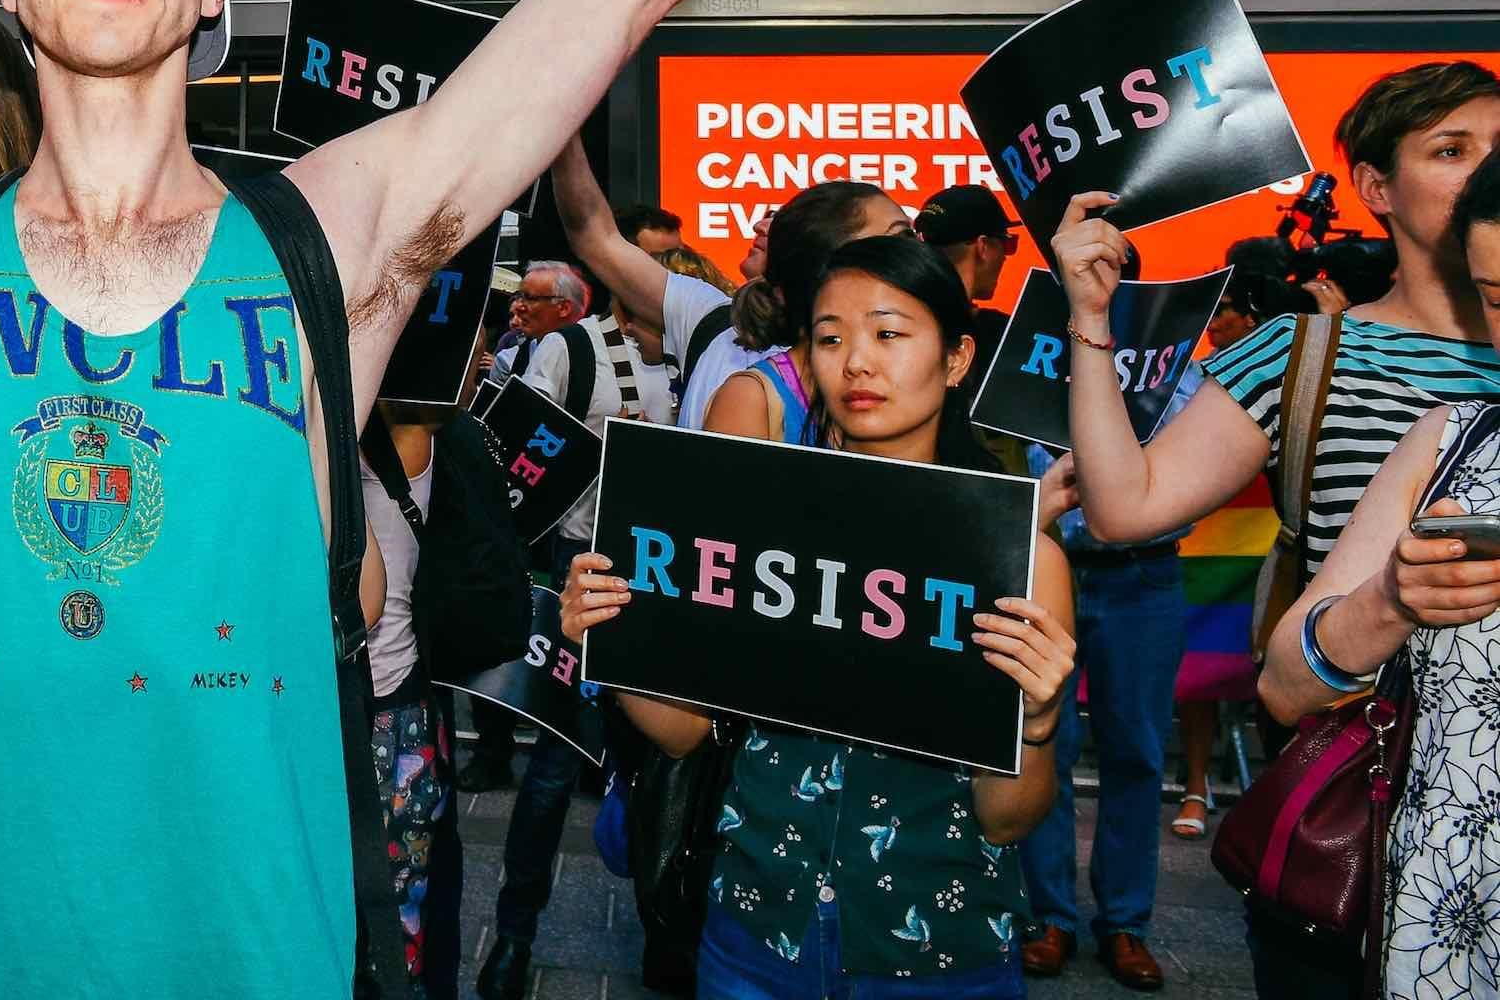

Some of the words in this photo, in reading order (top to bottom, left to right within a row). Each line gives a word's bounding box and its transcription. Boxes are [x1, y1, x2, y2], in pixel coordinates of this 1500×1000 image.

[302, 36, 437, 110] RESI
[697, 103, 981, 140] PIONEERIN
[1000, 47, 1222, 200] RESIST
[697, 152, 919, 191] CANCER
[932, 154, 1005, 191] TR
[1020, 333, 1192, 392] RSIST
[43, 397, 89, 420] FIRST
[91, 398, 139, 425] CLASS
[628, 526, 975, 651] RESIST
[190, 671, 251, 690] MIKEY
